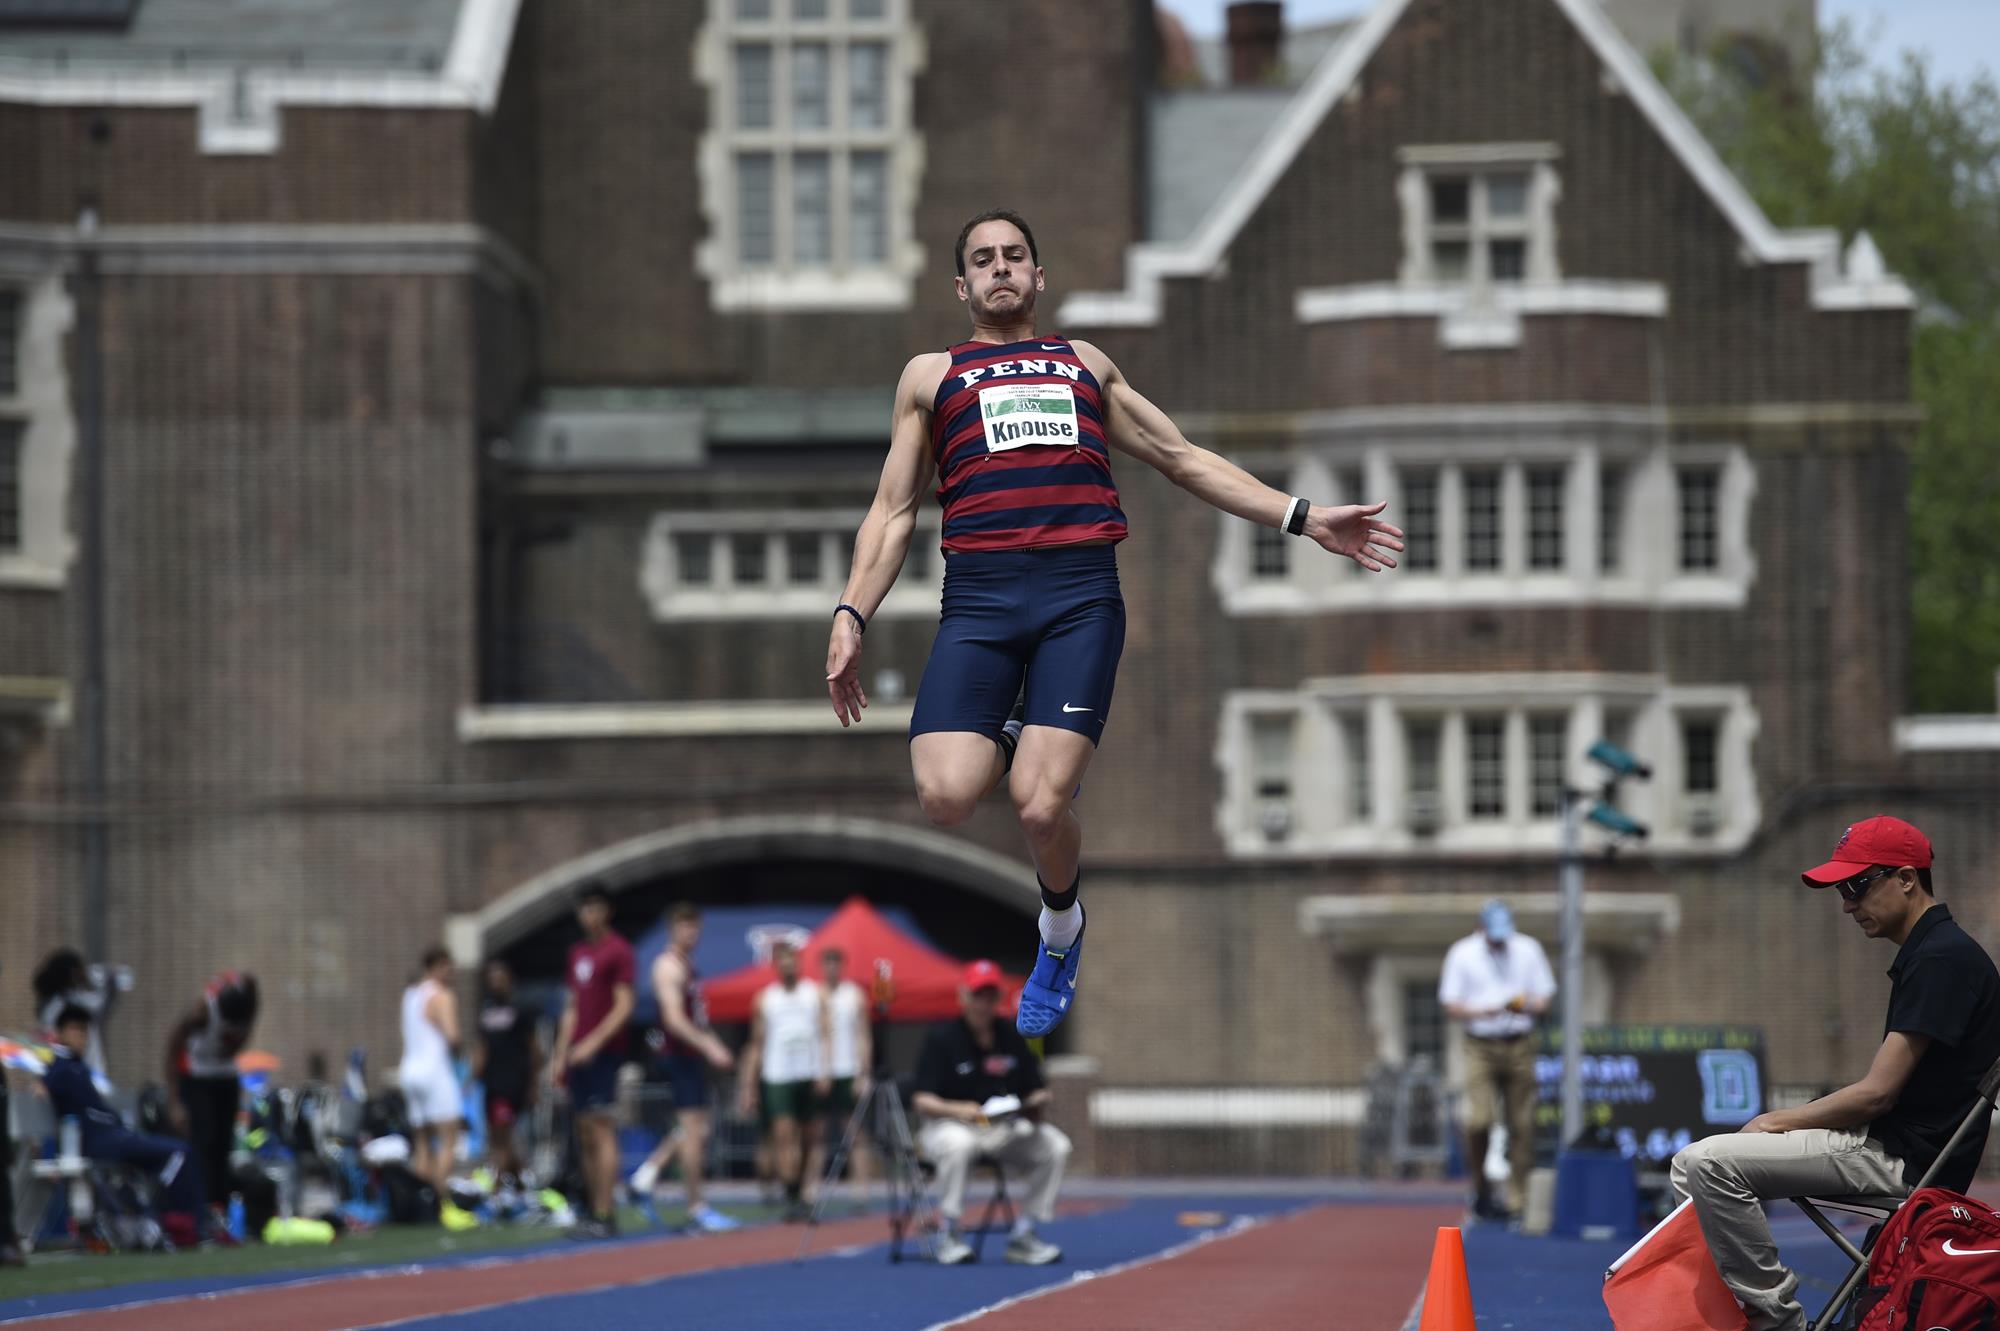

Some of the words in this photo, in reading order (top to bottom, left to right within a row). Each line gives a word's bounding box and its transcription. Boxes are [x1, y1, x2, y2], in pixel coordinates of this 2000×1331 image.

[958, 359, 1082, 388] PENN
[1022, 401, 1041, 409] IVY
[991, 420, 1073, 444] Knouse
